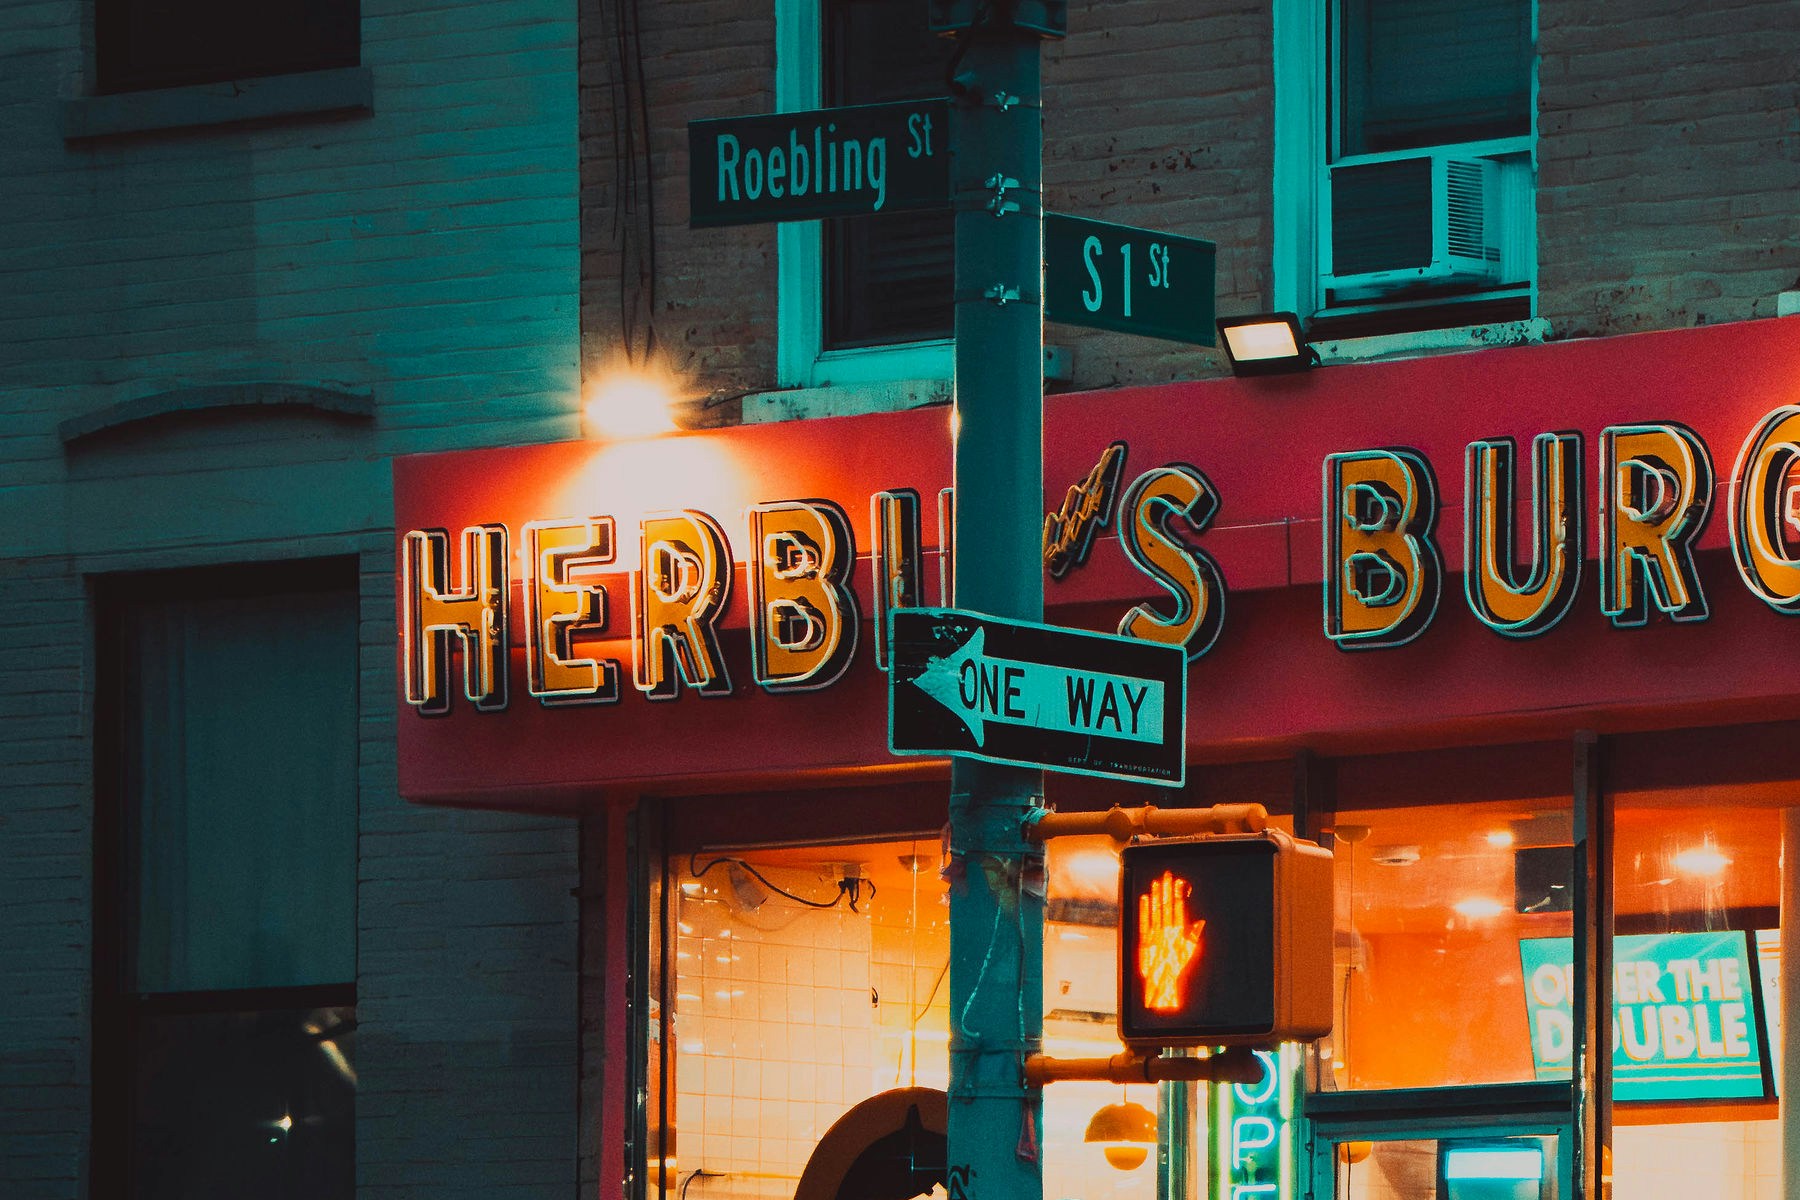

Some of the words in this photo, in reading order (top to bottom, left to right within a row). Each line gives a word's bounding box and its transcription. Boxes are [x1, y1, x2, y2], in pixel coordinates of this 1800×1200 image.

[716, 123, 888, 212] Roebling
[907, 113, 933, 159] St
[1082, 236, 1102, 313] S
[1120, 243, 1132, 317] 1
[1148, 246, 1171, 289] St
[402, 438, 1227, 716] HERBI'S
[958, 658, 1026, 720] ONE
[1065, 677, 1149, 736] WAY
[1109, 761, 1172, 777] TRANSPORTATION
[1531, 959, 1665, 1007] OER
[1667, 957, 1743, 1003] THE
[1535, 1002, 1751, 1064] DUBLE
